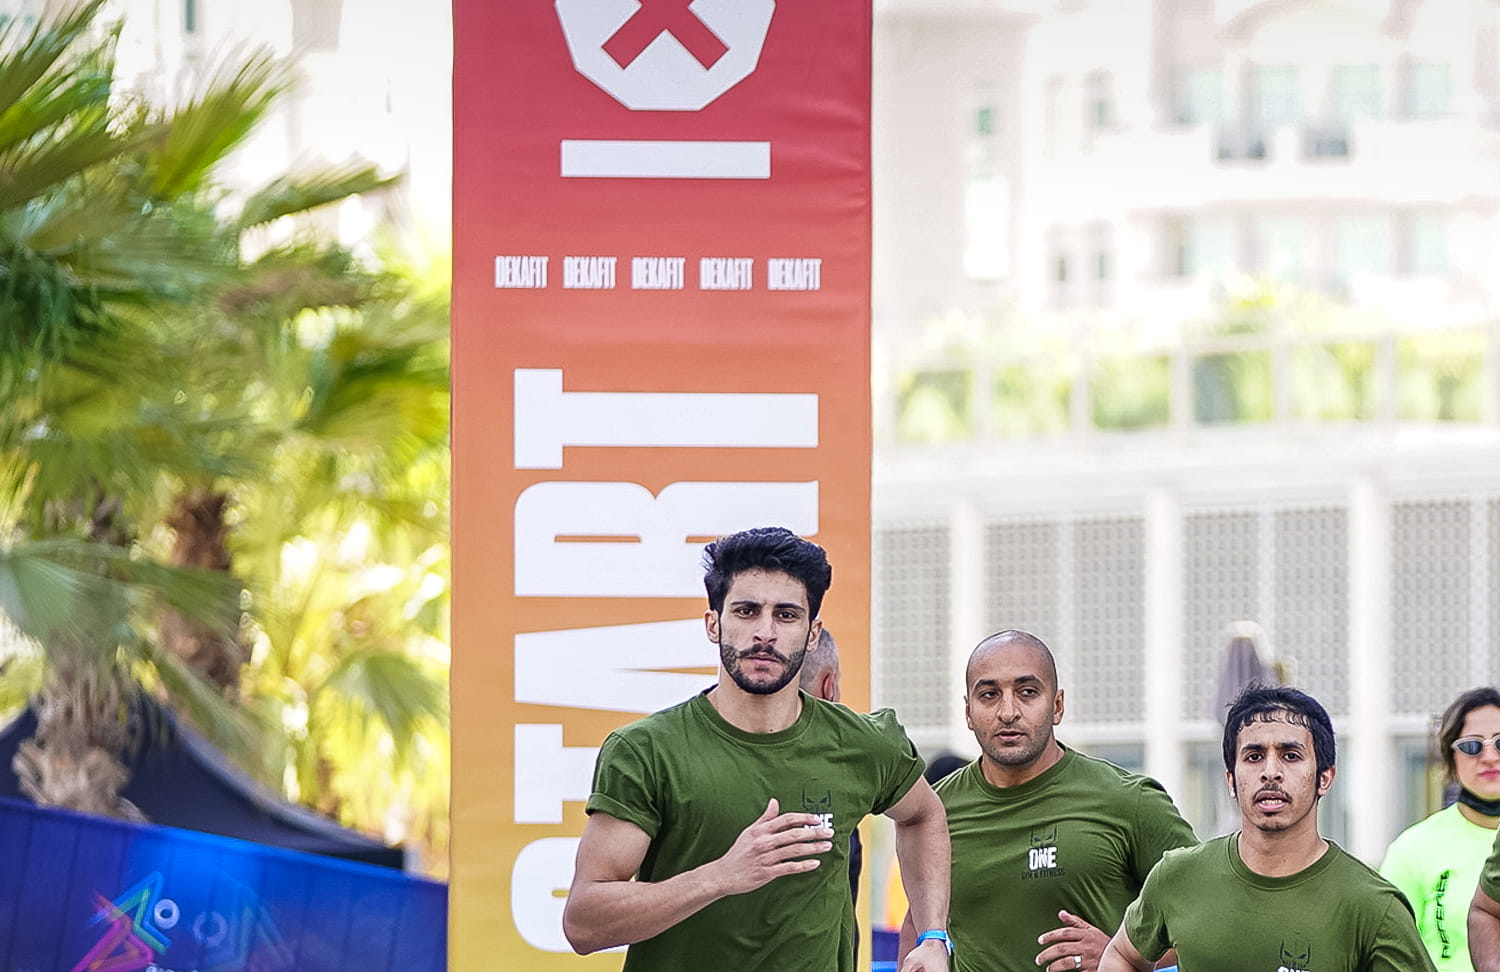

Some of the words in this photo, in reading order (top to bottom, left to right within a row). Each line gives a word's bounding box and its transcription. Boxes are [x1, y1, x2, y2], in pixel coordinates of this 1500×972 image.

[494, 255, 549, 289] DEKAFIT
[563, 256, 617, 290] DEKAFIT
[631, 256, 686, 290] DEKAFIT
[700, 257, 754, 291] DEKAFIT
[768, 257, 822, 291] DEKAFIT
[511, 368, 820, 953] ART
[1028, 846, 1058, 870] ONE
[1435, 870, 1450, 959] REFEREE
